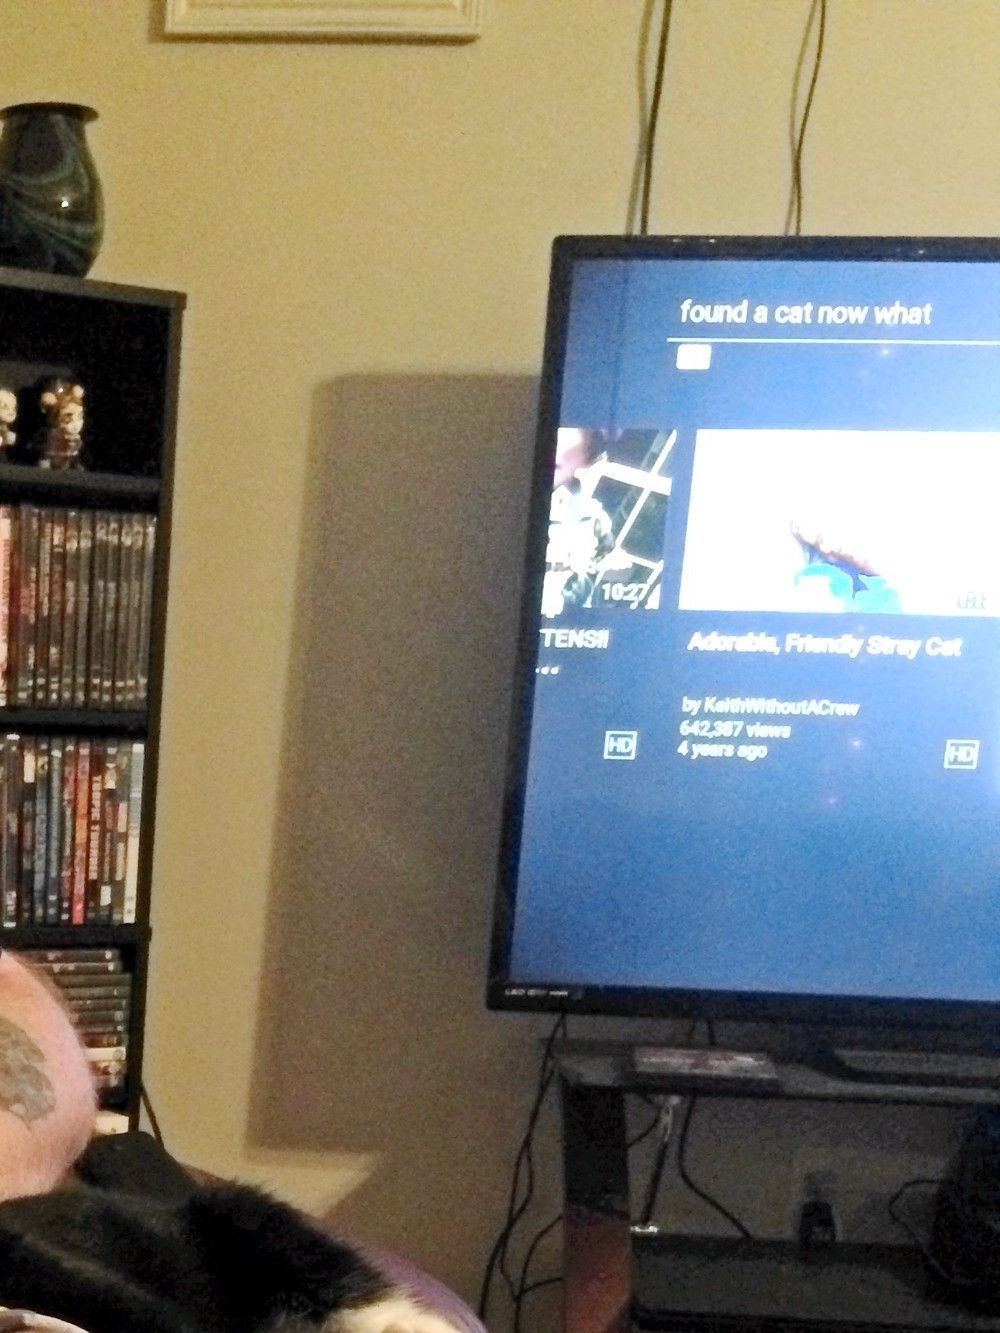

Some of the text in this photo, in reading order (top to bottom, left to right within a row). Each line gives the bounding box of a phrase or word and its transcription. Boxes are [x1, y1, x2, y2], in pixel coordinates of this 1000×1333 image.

[681, 298, 932, 325] found a cat now what
[602, 582, 648, 601] 10:27
[785, 633, 864, 658] Friendly
[867, 635, 921, 659] Stray
[925, 636, 963, 657] Cat
[682, 696, 702, 716] by
[746, 722, 792, 738] views
[607, 735, 634, 754] HD
[677, 740, 768, 761] 4 years ago
[948, 744, 975, 764] HD
